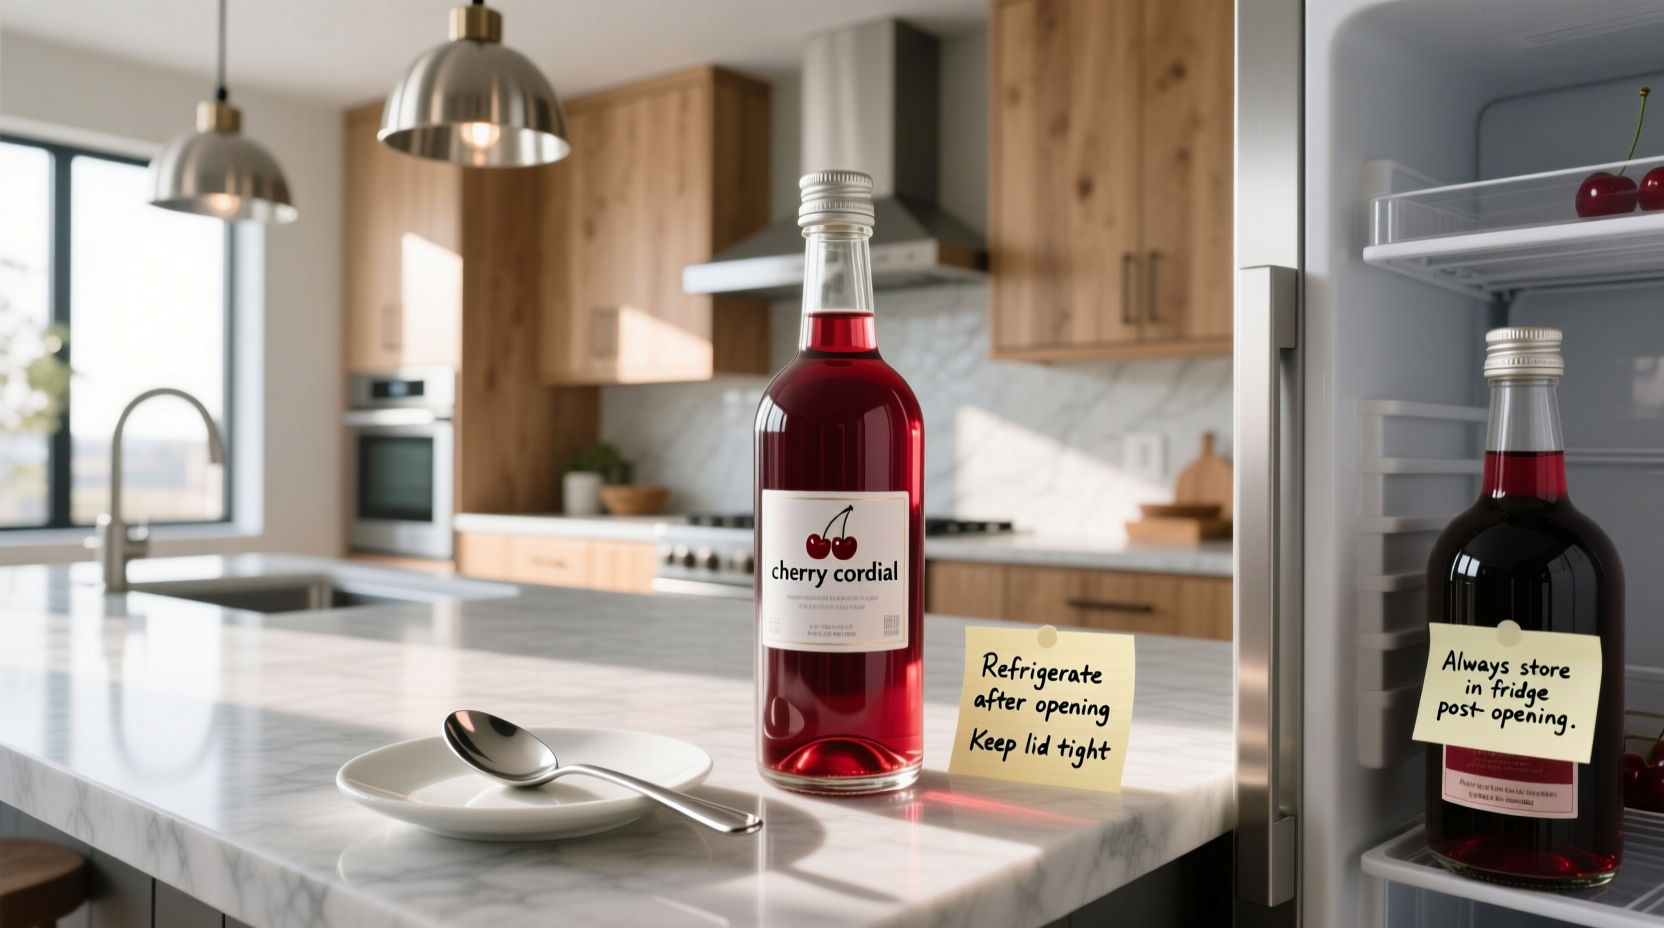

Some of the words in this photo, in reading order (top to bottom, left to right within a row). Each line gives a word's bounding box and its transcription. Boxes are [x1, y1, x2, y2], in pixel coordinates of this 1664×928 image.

[771, 559, 828, 588] cherry
[833, 560, 898, 582] cordial
[982, 651, 1103, 691] Refrigerate
[1441, 649, 1510, 680] Always
[1519, 658, 1571, 679] store
[973, 687, 1027, 711] after
[1035, 698, 1110, 727] opening
[1465, 679, 1482, 696] in
[1490, 678, 1550, 708] fridge
[1436, 700, 1485, 721] post
[1491, 707, 1576, 736] opening.
[969, 727, 1017, 762] Keep
[1024, 732, 1051, 756] lid
[1057, 736, 1112, 769] tight
